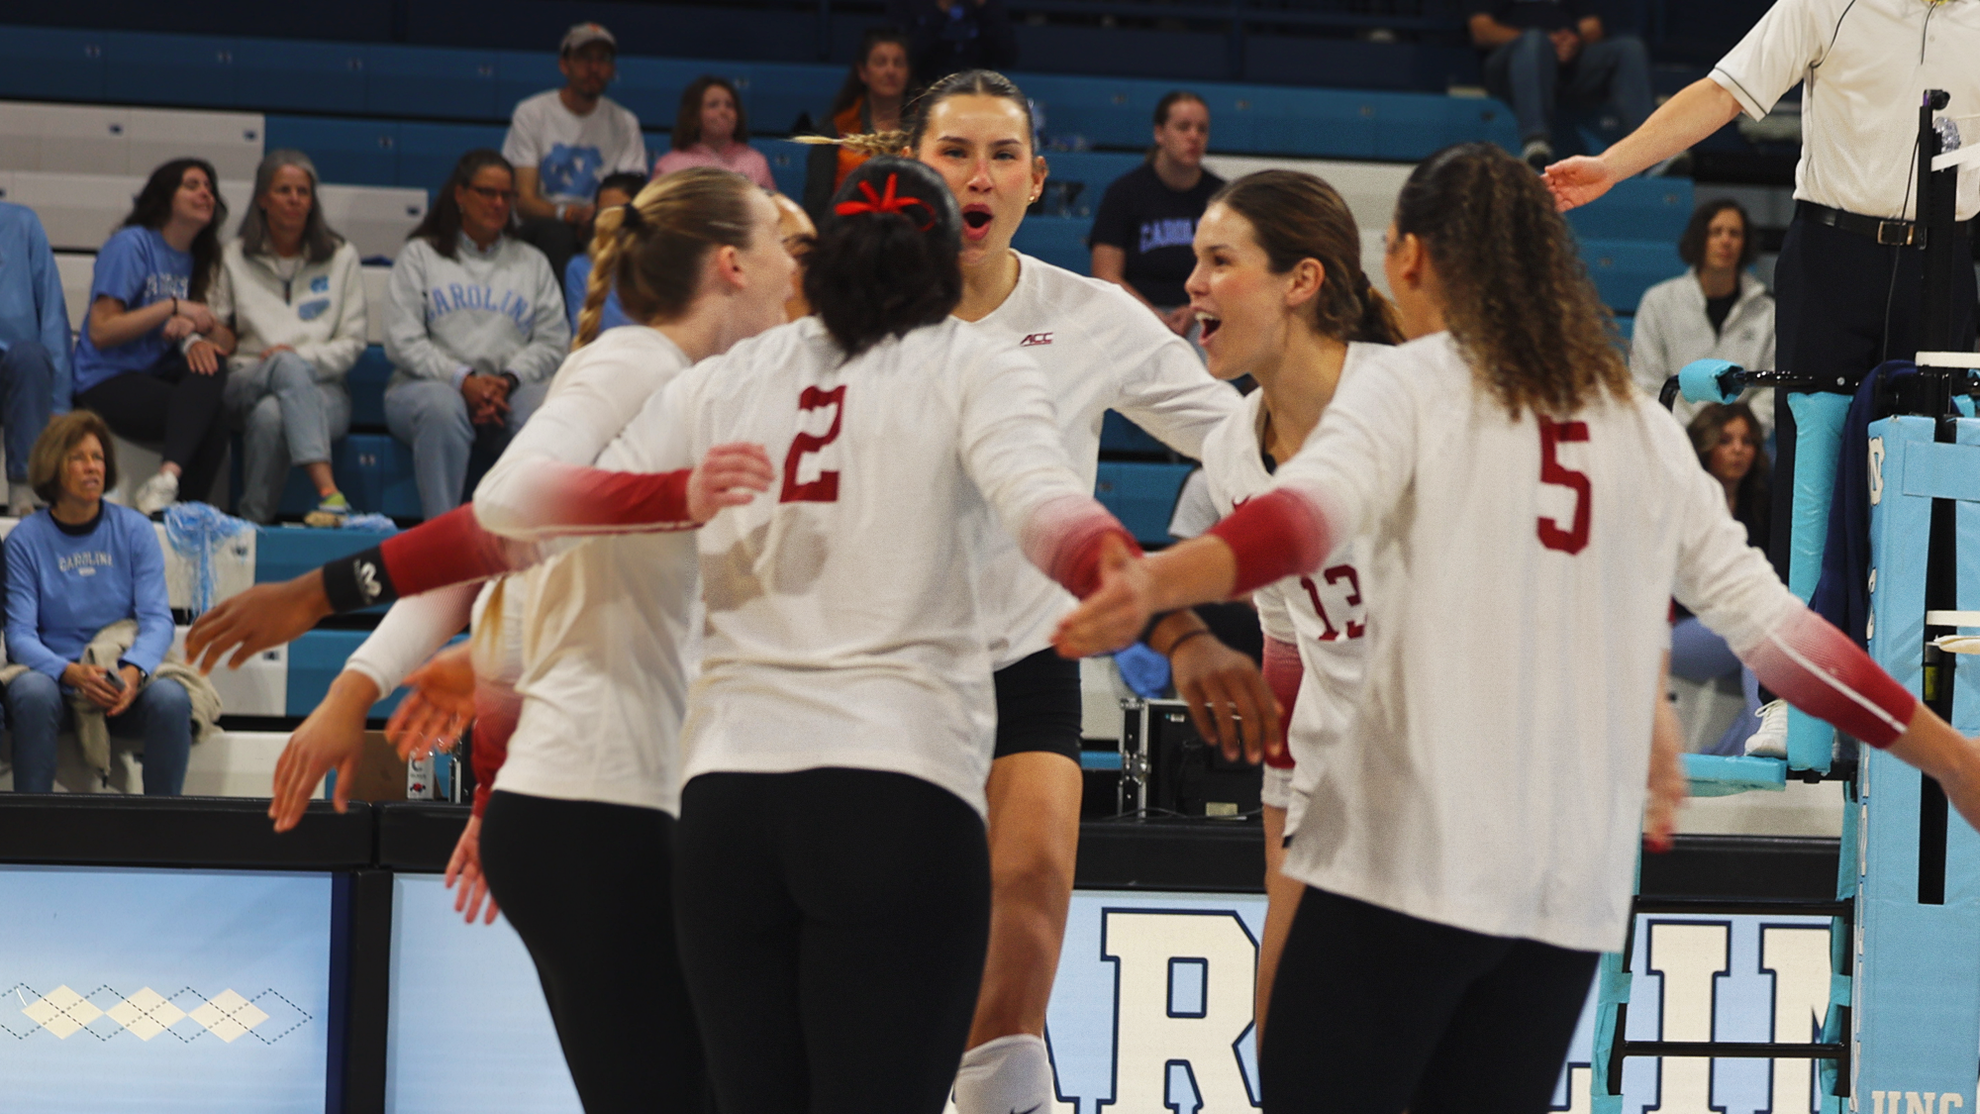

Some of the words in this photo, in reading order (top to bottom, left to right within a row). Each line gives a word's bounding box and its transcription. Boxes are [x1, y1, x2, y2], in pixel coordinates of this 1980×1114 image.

[1140, 217, 1200, 253] CAROL
[427, 282, 536, 336] AROLIN
[1020, 332, 1053, 347] ACC
[779, 384, 846, 503] 2
[1537, 414, 1592, 555] 5
[1301, 564, 1368, 641] 13
